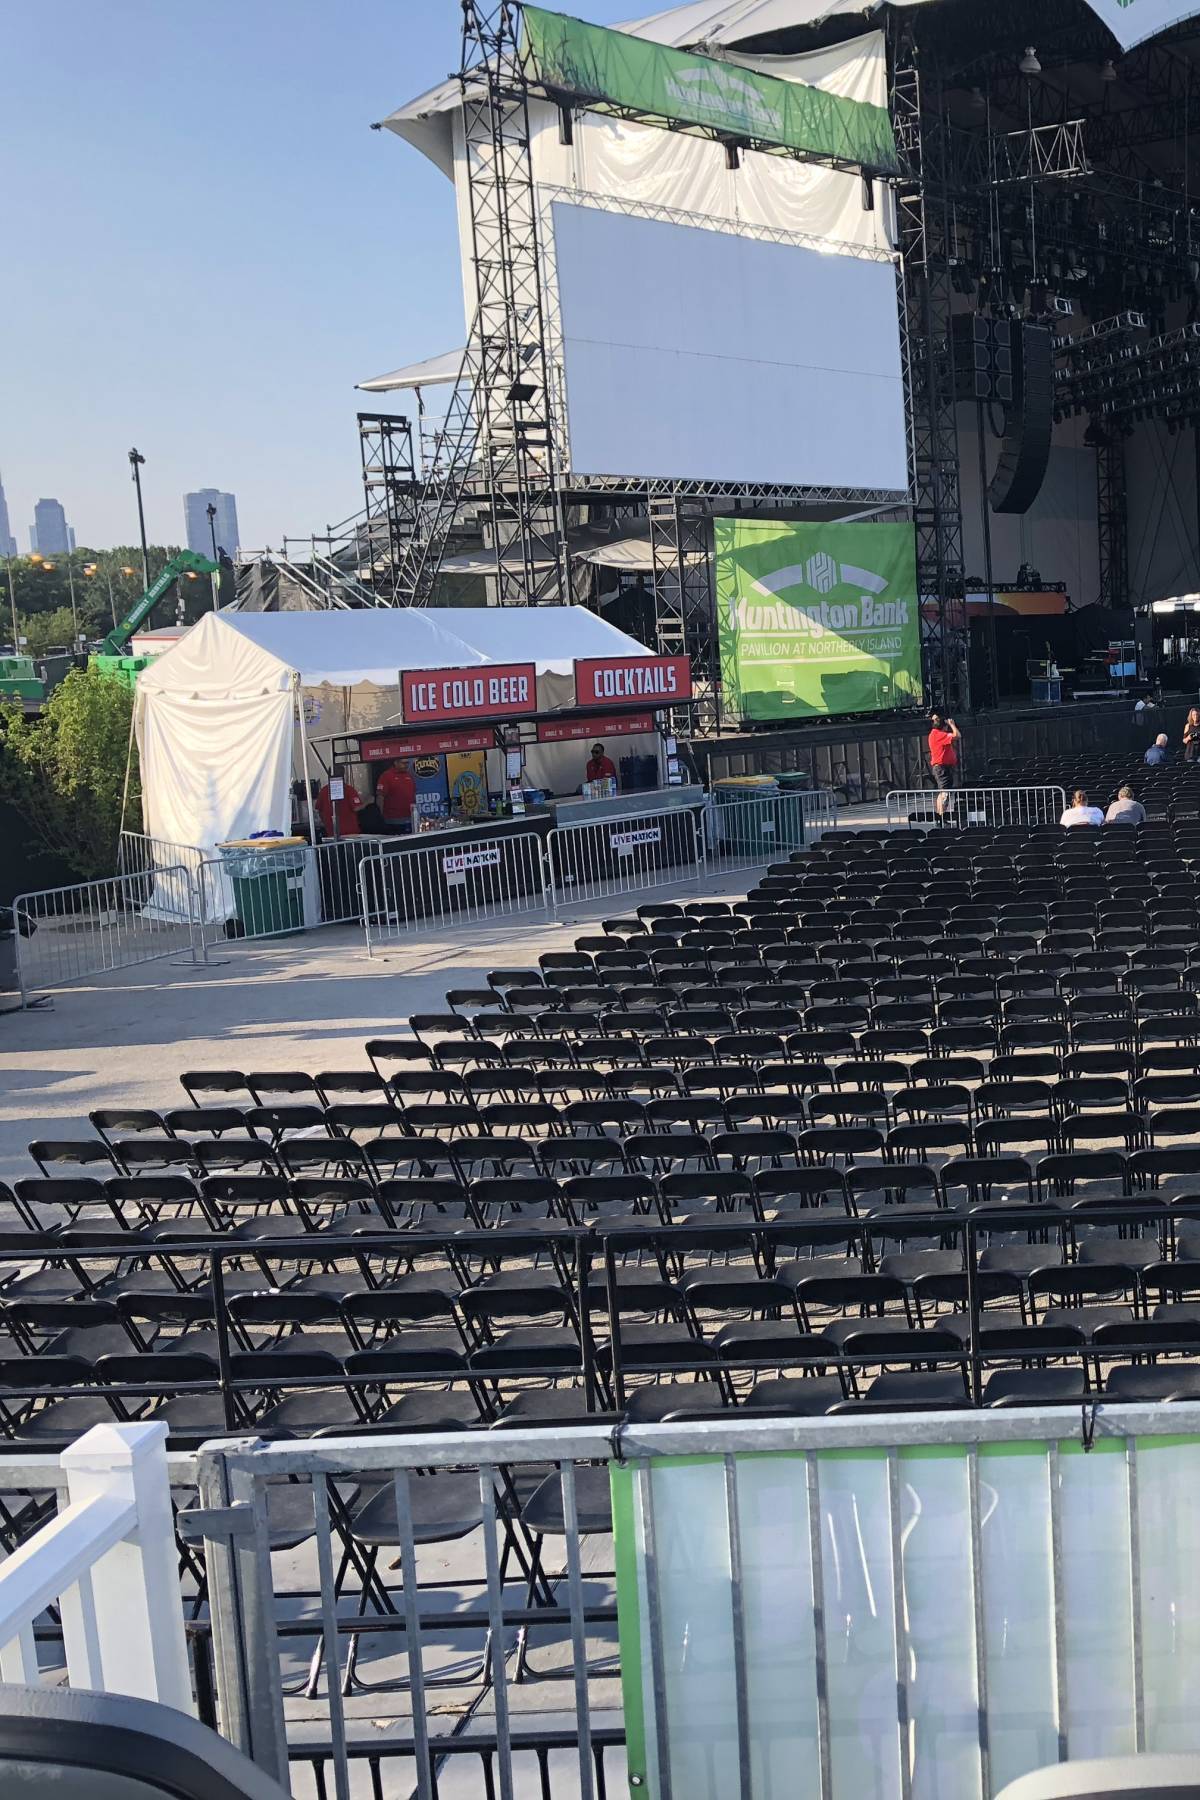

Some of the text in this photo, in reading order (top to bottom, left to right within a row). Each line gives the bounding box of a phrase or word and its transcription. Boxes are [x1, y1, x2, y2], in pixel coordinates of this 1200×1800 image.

[729, 595, 909, 638] Huntington Bank
[741, 636, 902, 656] PAVILION AT NORTHERLY ISLAND
[593, 666, 677, 698] COCKTAILS
[411, 676, 528, 712] ICE COLD BEER
[416, 792, 440, 804] BUD
[613, 830, 659, 846] LIVE NATION
[446, 857, 464, 870] LIVE
